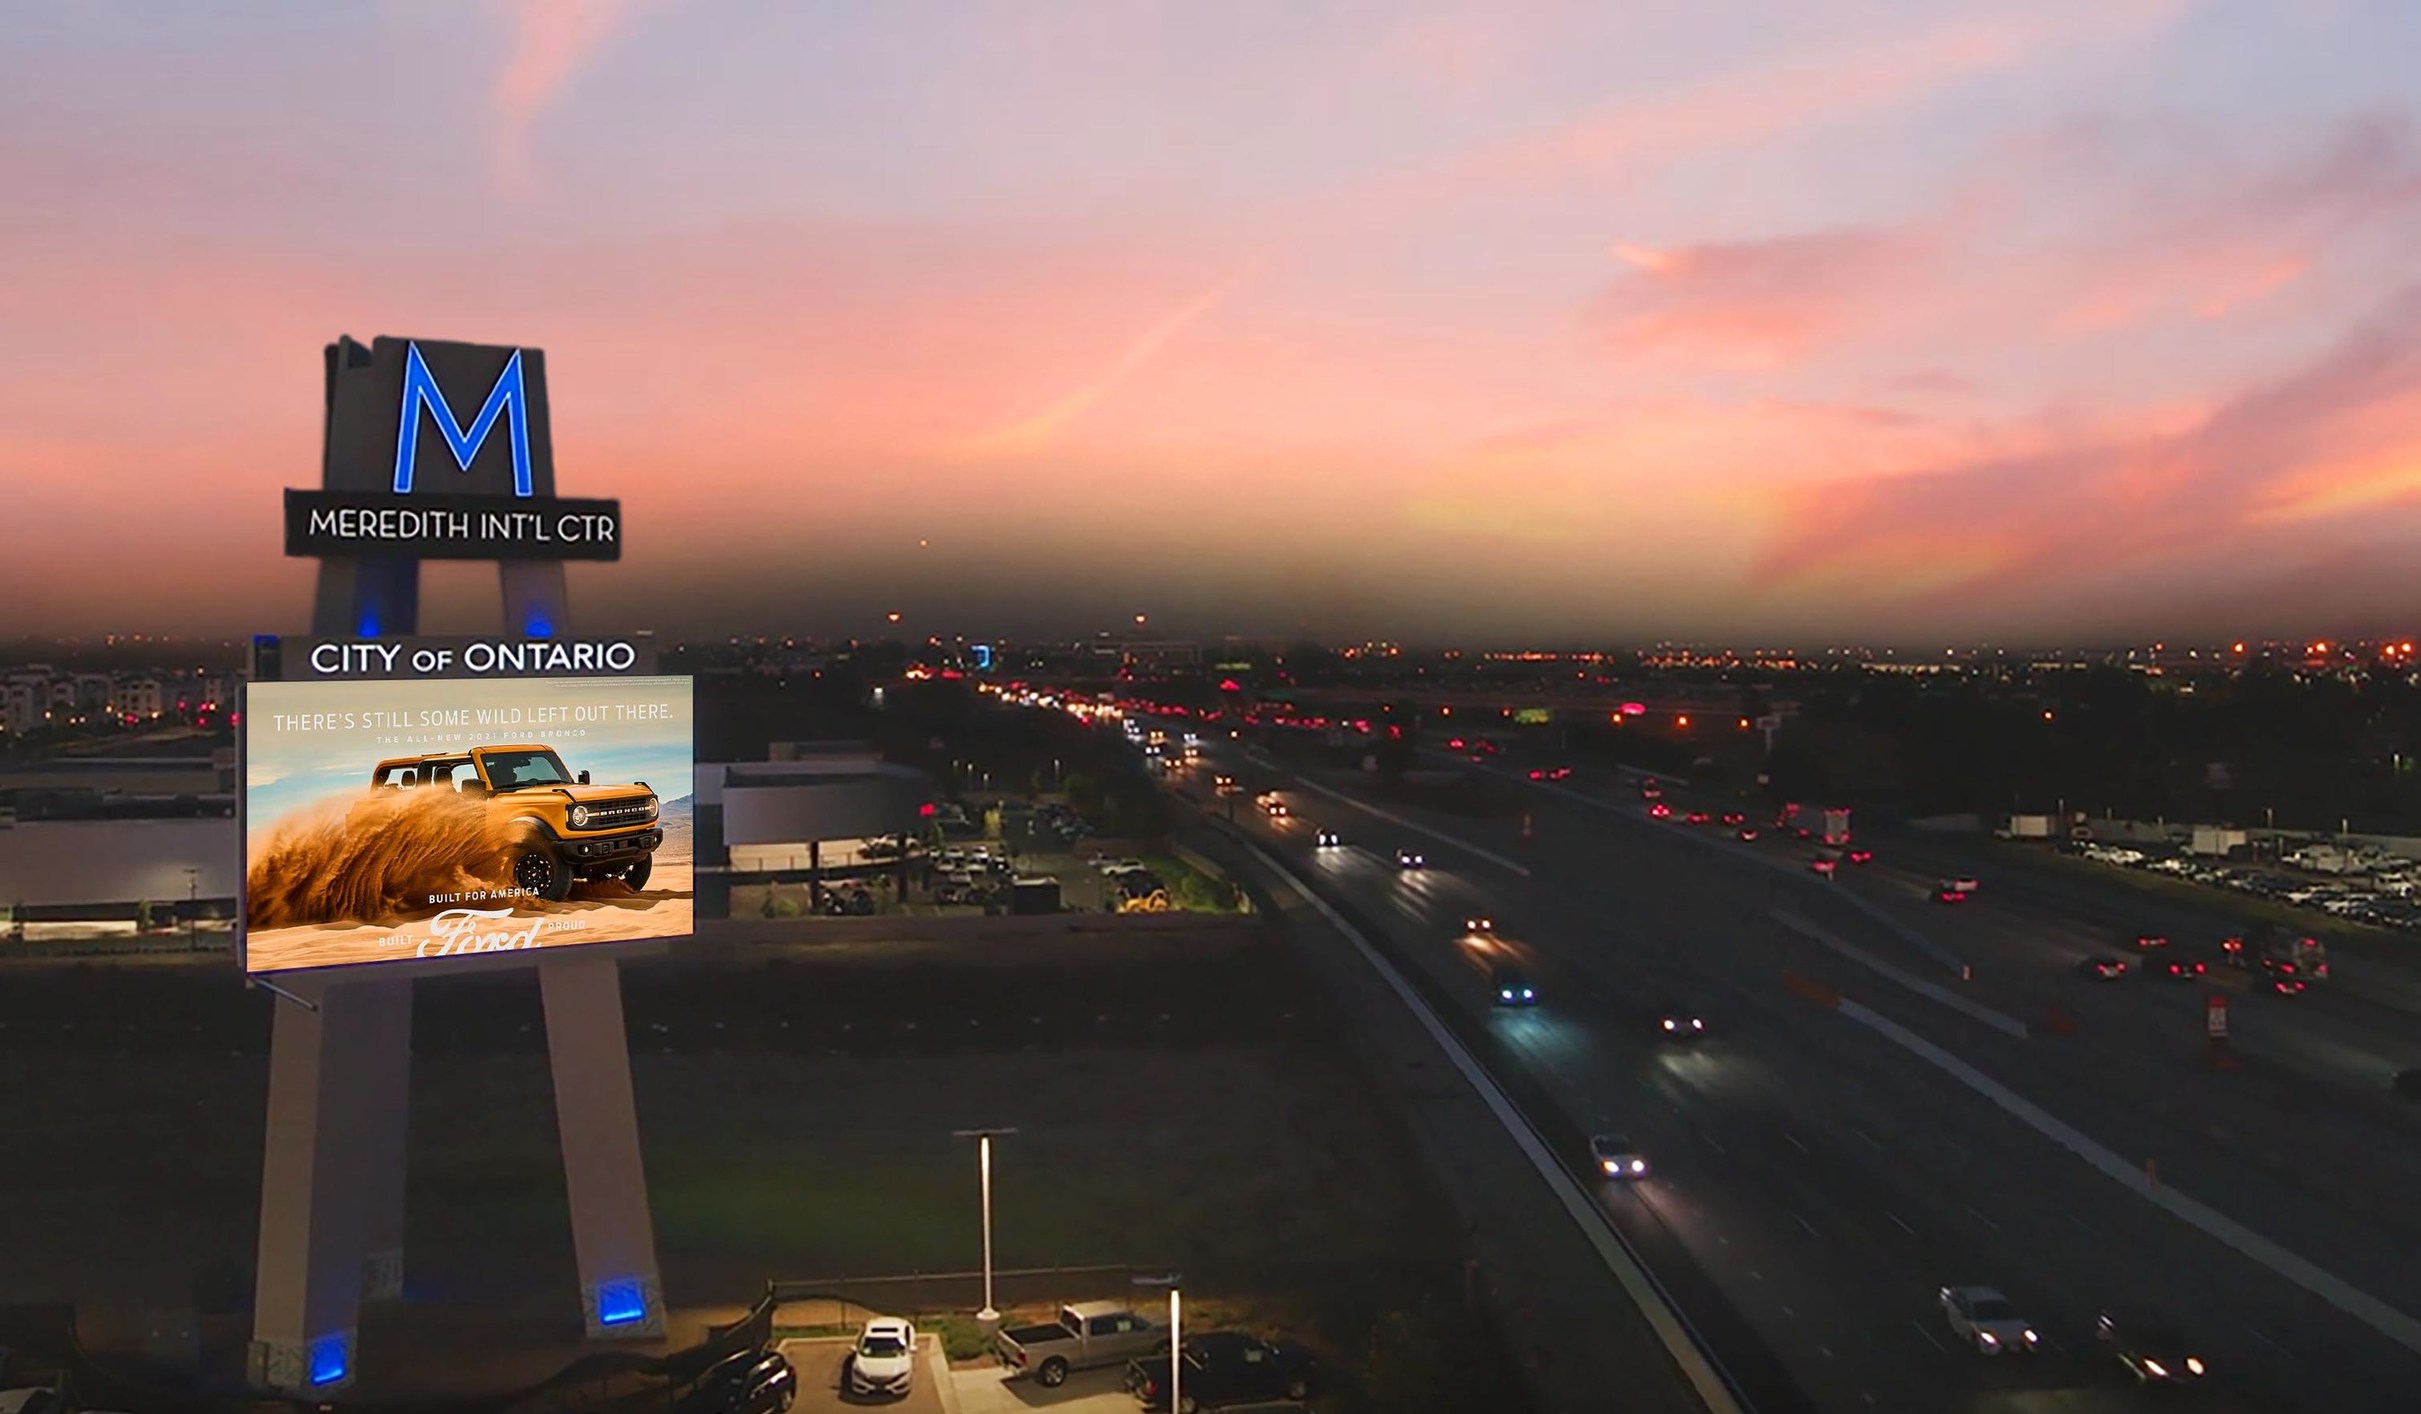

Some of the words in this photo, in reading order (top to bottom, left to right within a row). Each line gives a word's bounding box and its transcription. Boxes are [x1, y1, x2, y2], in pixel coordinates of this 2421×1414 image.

[393, 340, 533, 497] M
[309, 509, 469, 540] MEREDITH
[481, 512, 551, 541] INT'L
[557, 514, 615, 542] CTR
[311, 643, 402, 673] CITY
[412, 650, 452, 672] OF
[464, 642, 635, 671] ONTARIO
[273, 713, 355, 731] THERE'S
[362, 711, 413, 729] STILL
[420, 709, 470, 727] SOME
[476, 708, 521, 725] WILD
[528, 706, 569, 723] LEFT
[575, 705, 609, 721] OUT
[615, 703, 674, 720] THERE.
[376, 736, 399, 744] THE
[407, 734, 461, 743] ALL-NEW
[469, 733, 496, 741] 2021
[503, 731, 533, 739] FORD
[541, 729, 586, 738] BRONCO
[429, 892, 461, 904] BUILT
[465, 891, 486, 902] FOR
[490, 886, 540, 900] AMERICA
[378, 934, 414, 947] BUILT
[547, 920, 586, 932] PROUD
